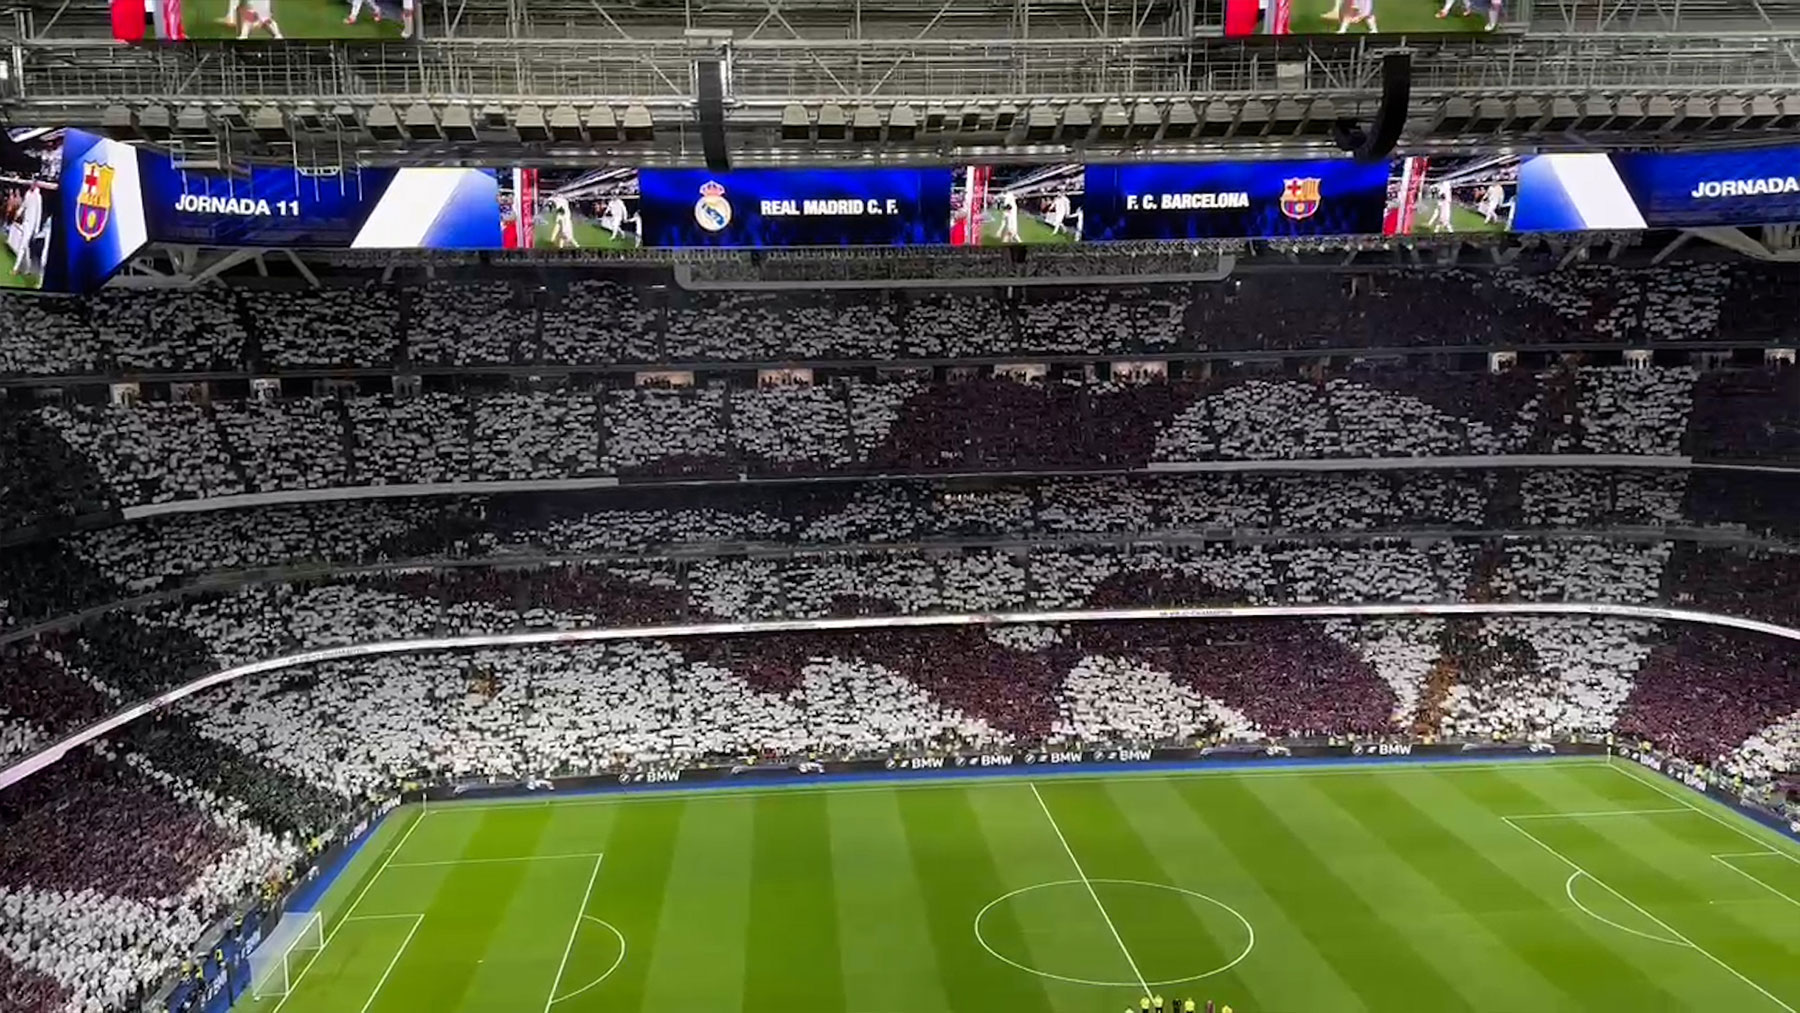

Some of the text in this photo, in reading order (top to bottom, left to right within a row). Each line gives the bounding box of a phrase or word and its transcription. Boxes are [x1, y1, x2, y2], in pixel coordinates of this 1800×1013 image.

[1691, 176, 1800, 198] JORNADA
[174, 193, 300, 217] JORNADA 11
[760, 198, 899, 216] REAL MADRID C. F.
[1126, 191, 1250, 210] F. C. BARCELONA
[1119, 748, 1153, 762] BMW
[1379, 742, 1412, 756] BMW
[911, 757, 944, 770] BMW
[981, 754, 1013, 767] BMW
[1050, 751, 1083, 764] BMW
[646, 769, 681, 783] BMW
